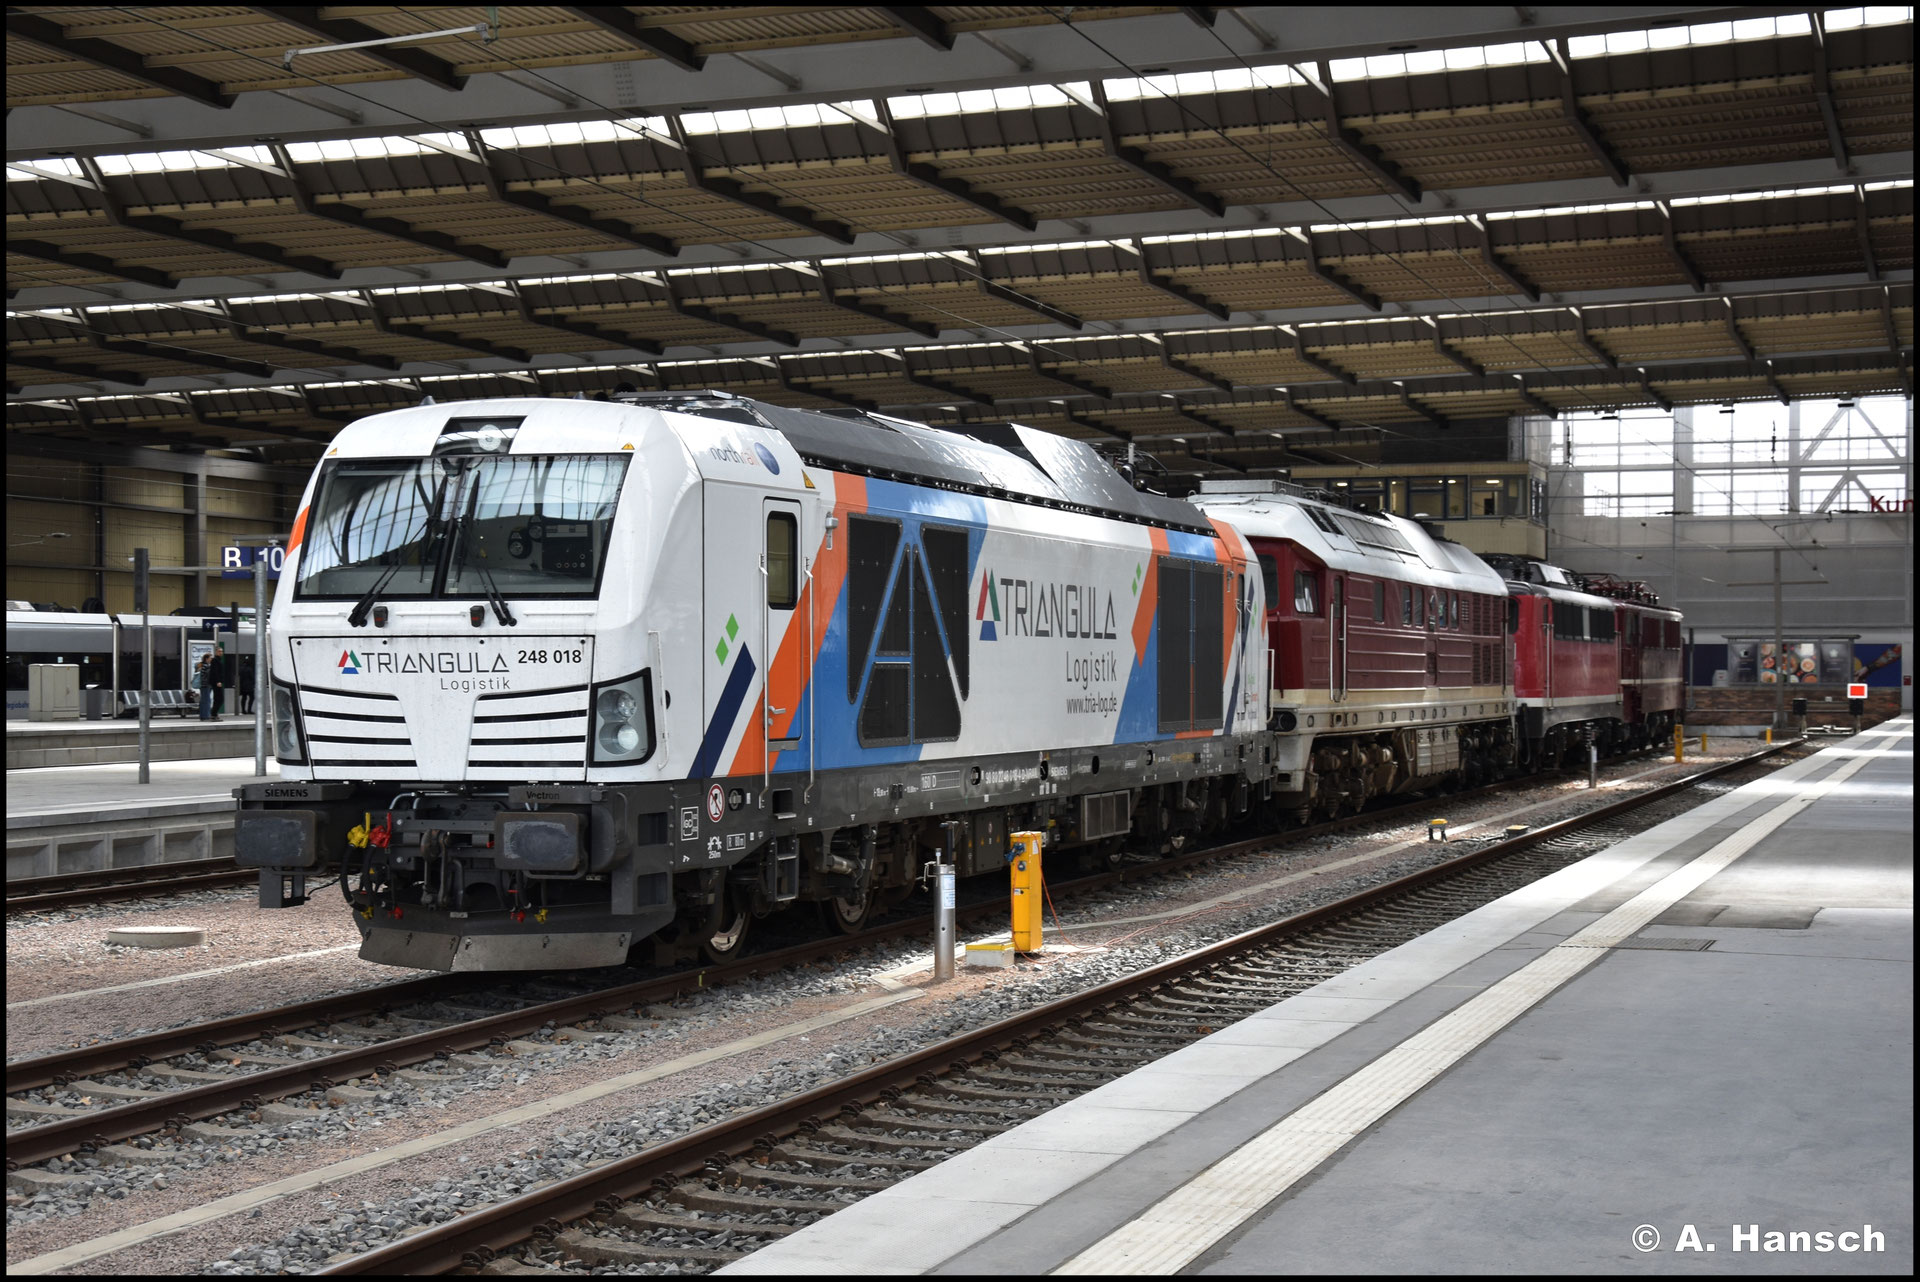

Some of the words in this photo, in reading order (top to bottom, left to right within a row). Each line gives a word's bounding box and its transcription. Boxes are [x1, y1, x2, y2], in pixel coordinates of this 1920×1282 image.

[224, 547, 242, 572] B
[258, 547, 285, 572] 10
[1000, 577, 1117, 640] TRIANGULA
[361, 652, 510, 673] TRIANGULA
[517, 649, 548, 664] 248
[553, 649, 582, 664] 018
[1066, 650, 1117, 690] Logistik
[440, 677, 511, 693] Logistik
[1066, 691, 1117, 718] www.tria-log.de
[264, 788, 309, 798] SIEMENS
[526, 790, 560, 800] Vectron
